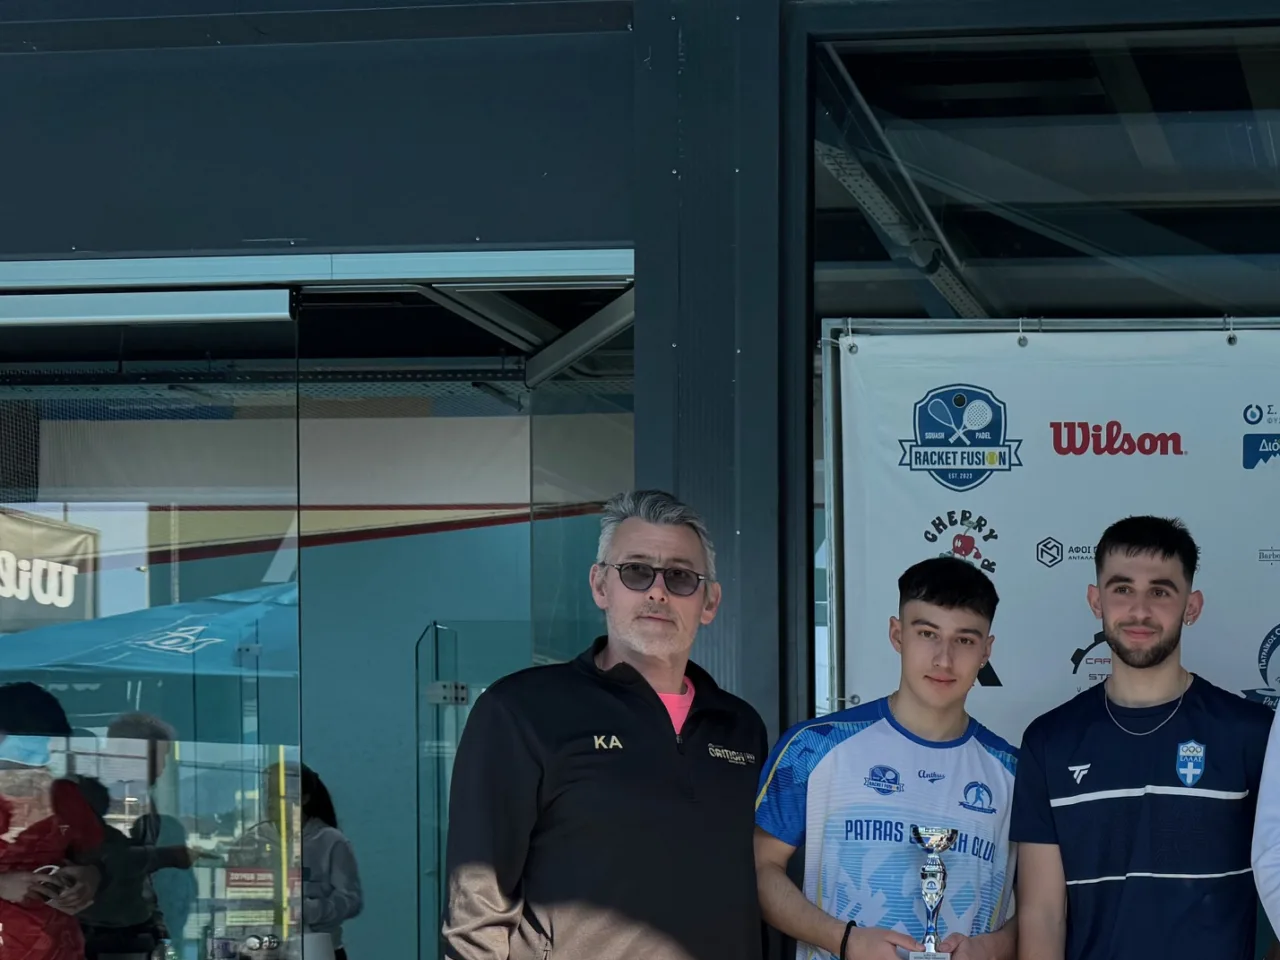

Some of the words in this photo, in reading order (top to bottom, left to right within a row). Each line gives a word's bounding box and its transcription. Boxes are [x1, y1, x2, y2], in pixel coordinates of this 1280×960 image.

[1049, 420, 1184, 456] Wilson
[914, 451, 958, 466] RACKET
[960, 451, 1007, 466] FUSION
[593, 735, 623, 750] KA
[845, 819, 904, 843] PATRAS
